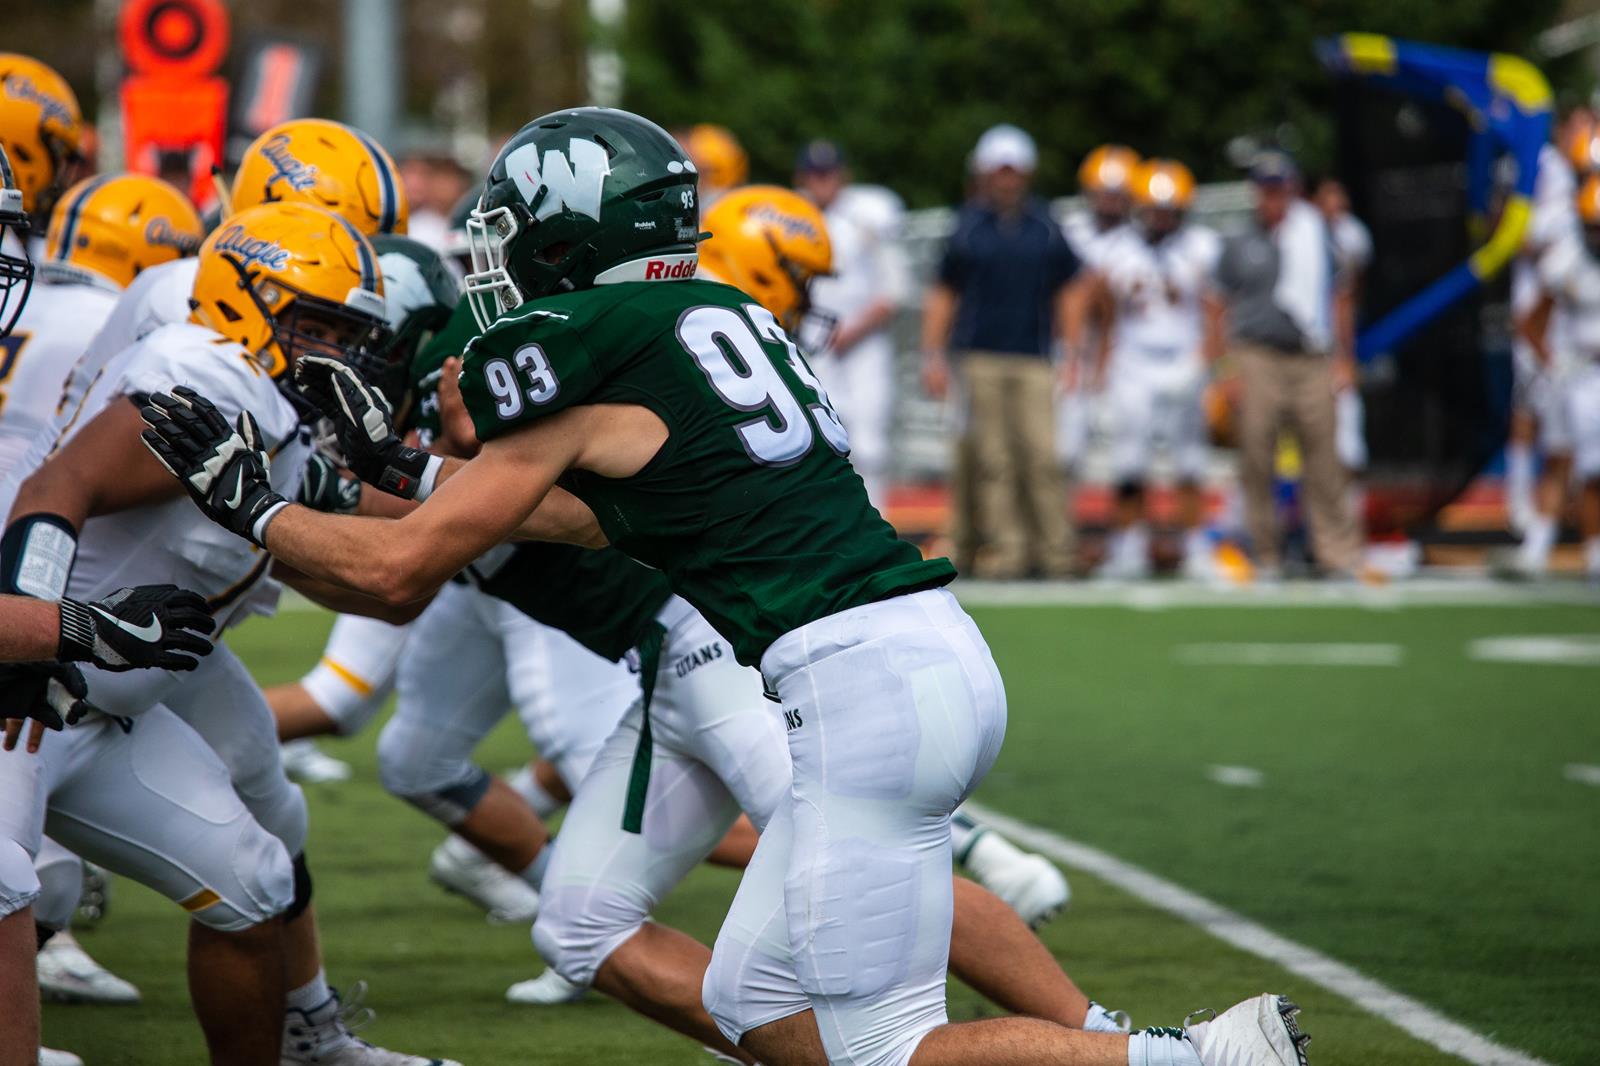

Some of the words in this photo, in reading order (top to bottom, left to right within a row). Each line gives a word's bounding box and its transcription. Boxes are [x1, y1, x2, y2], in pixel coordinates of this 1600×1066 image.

[260, 134, 318, 191] Augie
[505, 137, 611, 223] W
[681, 190, 694, 209] 93
[214, 225, 292, 272] Augie
[483, 342, 560, 420] 93
[784, 708, 803, 731] NS
